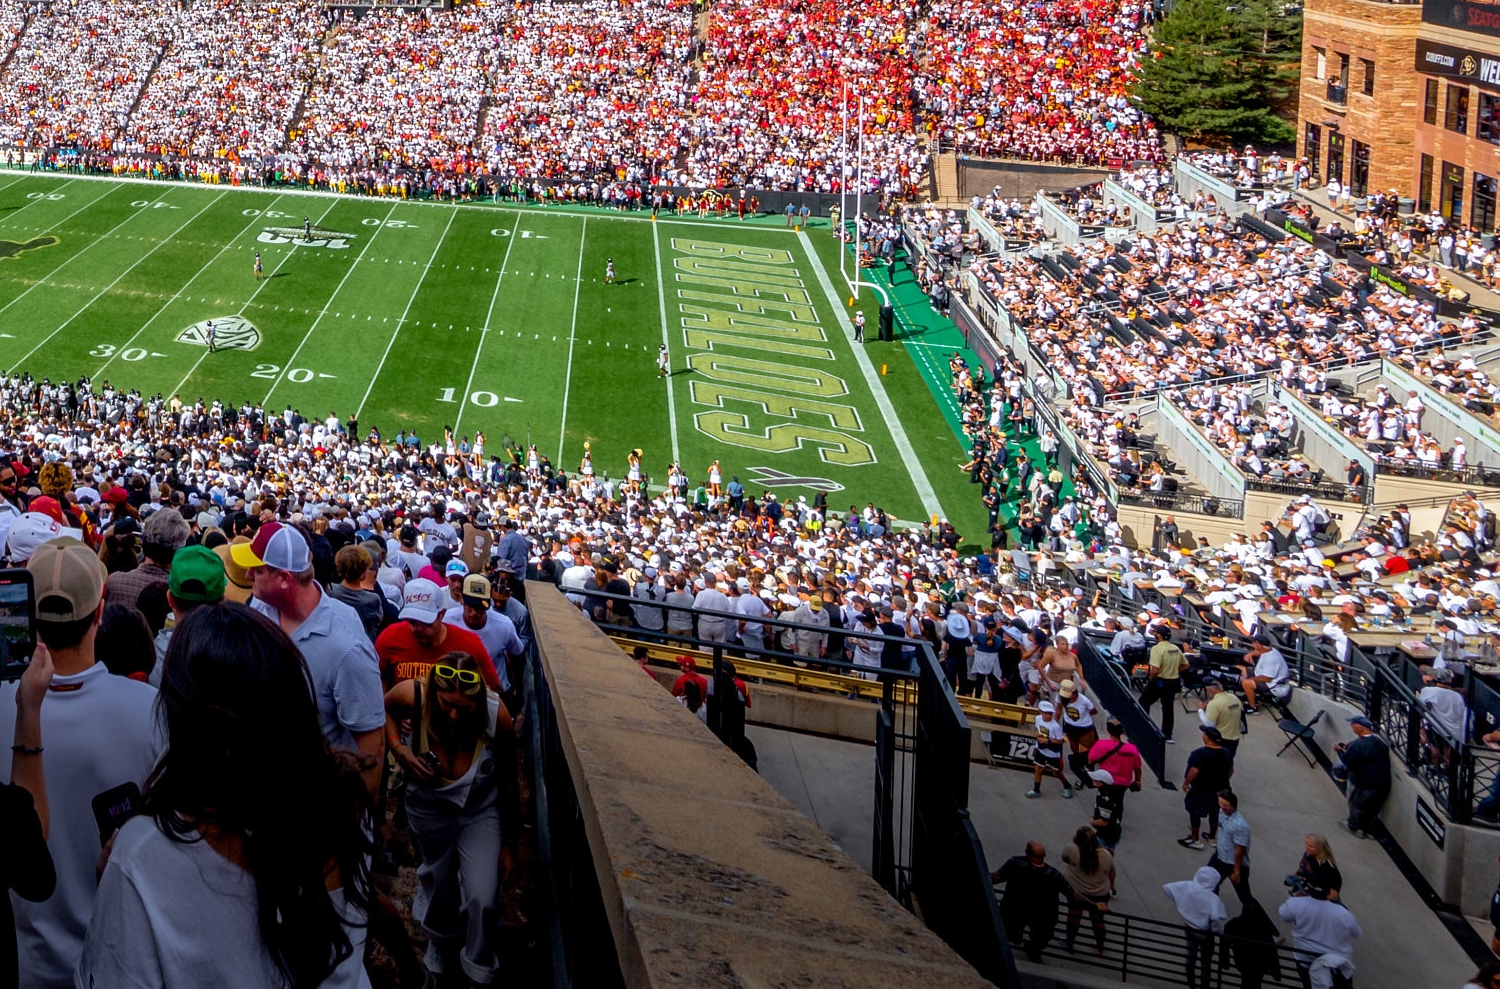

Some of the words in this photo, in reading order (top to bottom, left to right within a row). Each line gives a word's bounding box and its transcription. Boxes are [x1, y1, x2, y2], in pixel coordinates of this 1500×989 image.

[89, 344, 148, 361] 30
[670, 237, 877, 467] BUFFALOES
[250, 364, 315, 384] 20
[437, 387, 500, 408] 10
[405, 593, 432, 604] USC
[1010, 735, 1038, 744] SECTIO
